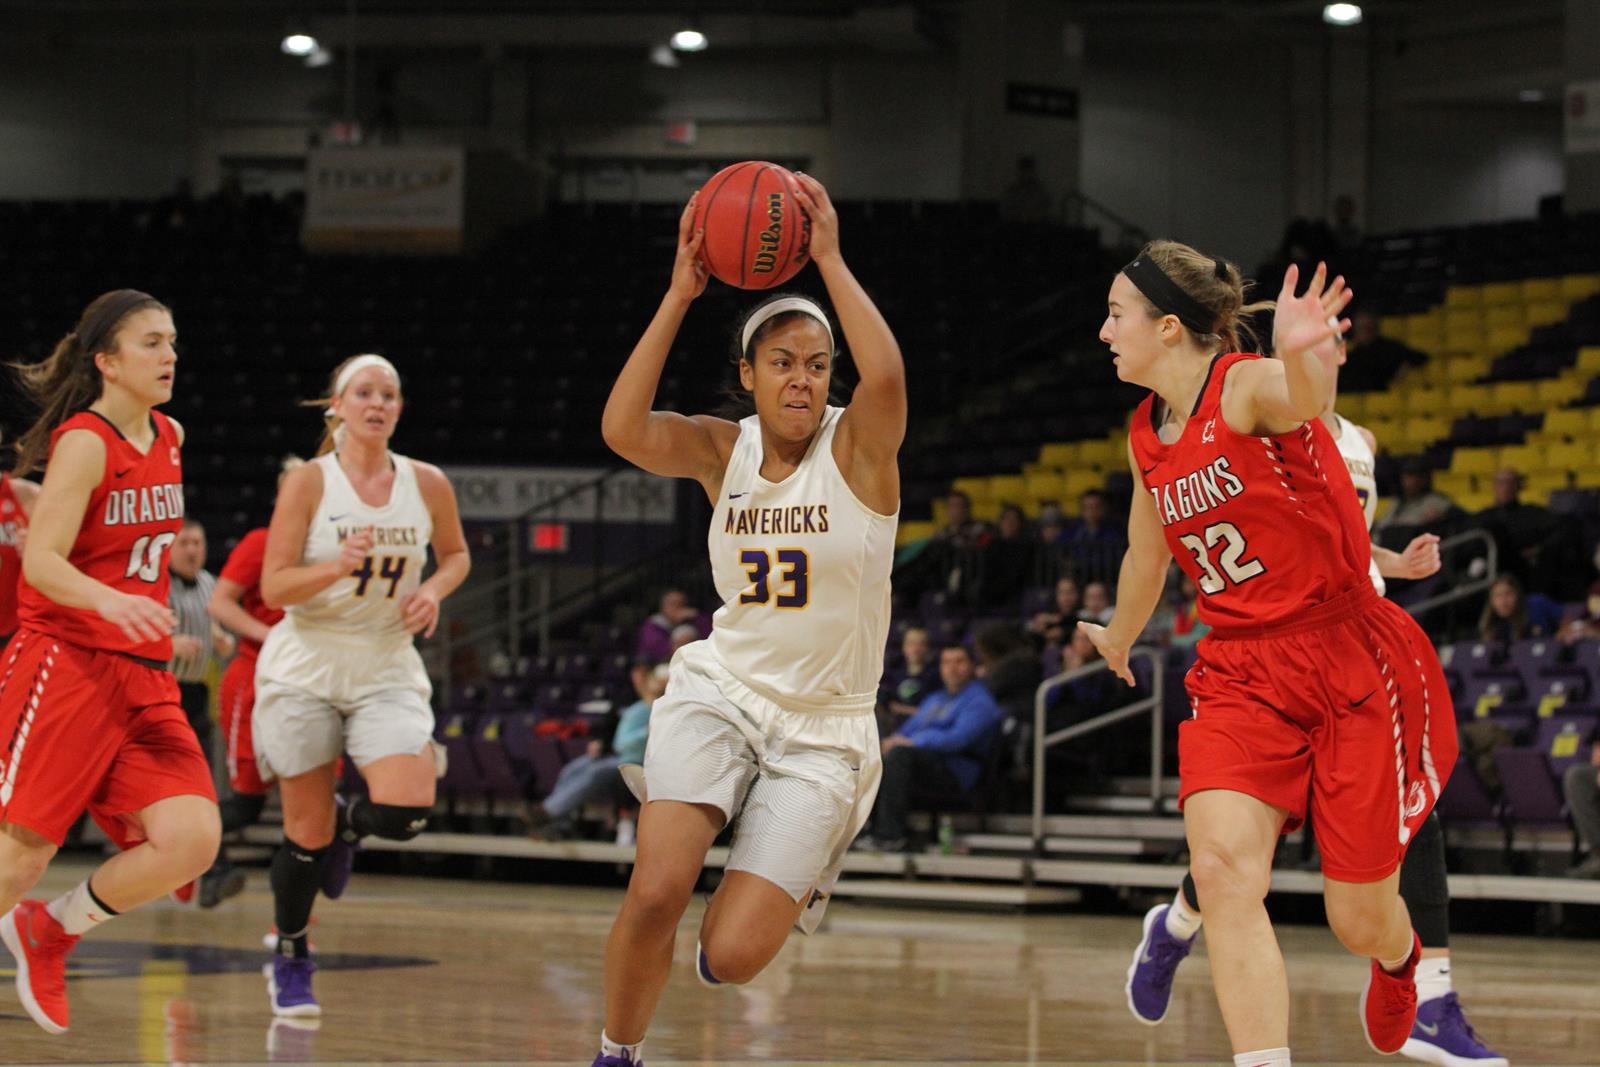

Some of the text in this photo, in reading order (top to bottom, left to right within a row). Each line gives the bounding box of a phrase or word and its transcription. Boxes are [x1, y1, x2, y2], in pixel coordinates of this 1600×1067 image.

[753, 192, 784, 274] Wilson
[725, 504, 829, 535] MAVERICKS
[351, 554, 408, 600] 44
[738, 547, 810, 611] 33
[1178, 521, 1267, 595] 32
